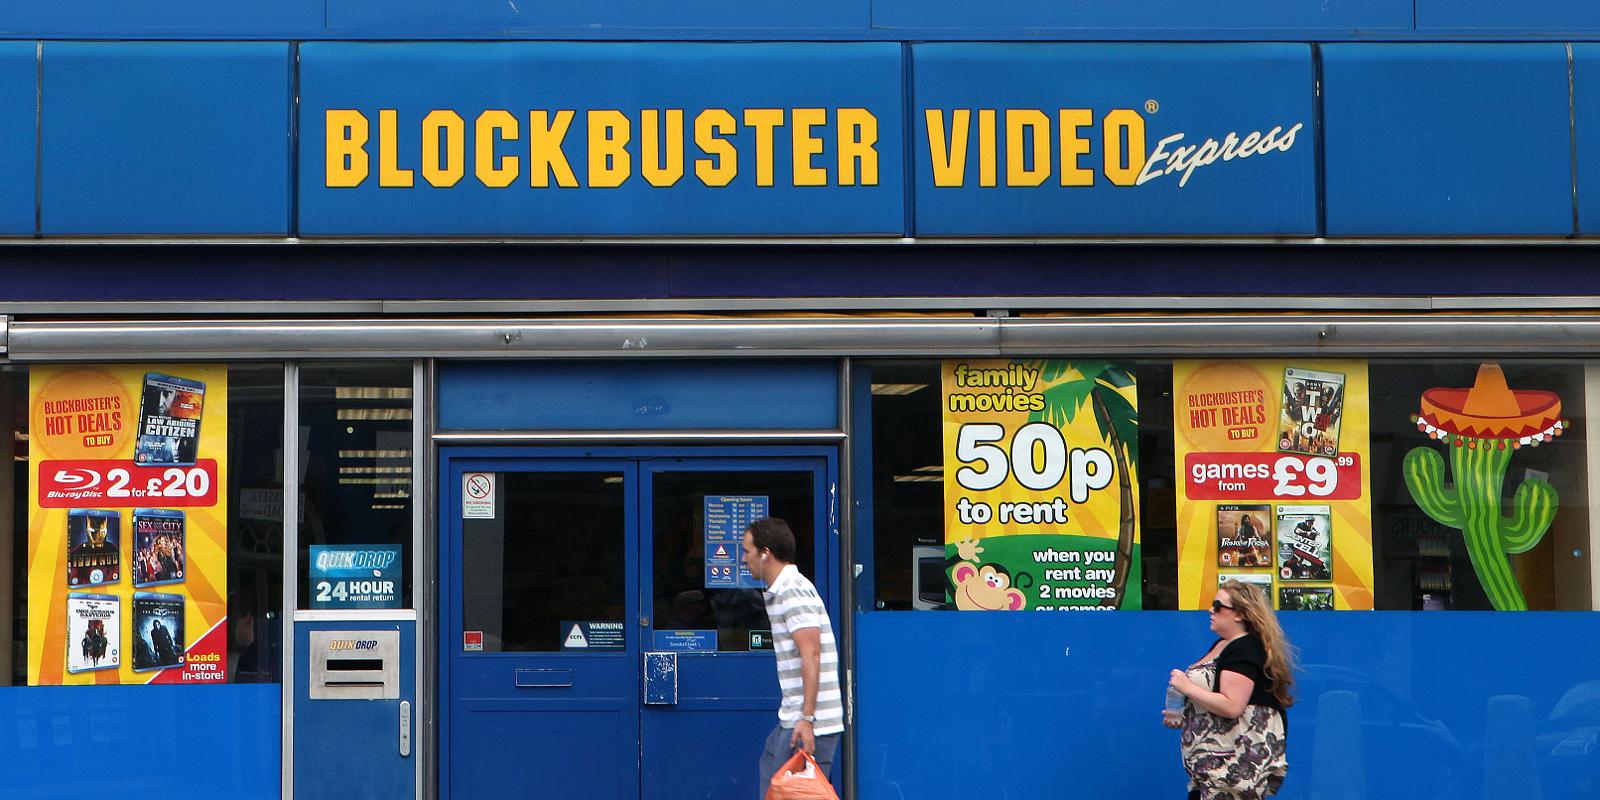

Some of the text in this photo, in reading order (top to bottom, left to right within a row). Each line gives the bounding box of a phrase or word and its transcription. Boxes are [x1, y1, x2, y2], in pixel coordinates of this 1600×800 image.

[325, 108, 1147, 189] BLOCKBUSTER VIDEO
[1136, 122, 1304, 188] Express
[955, 363, 1039, 392] family
[45, 396, 121, 415] BLOCKBUSTER'S
[949, 388, 1046, 413] movies
[1188, 390, 1264, 408] BLOCKBUSTER'S
[45, 411, 122, 436] HOT DEALS
[147, 417, 165, 426] LAW
[1190, 405, 1266, 428] HOT DEALS
[85, 435, 112, 446] TO BUY
[145, 424, 196, 439] CITIZEN
[1230, 428, 1256, 439] TO BUY
[955, 421, 1114, 503] 50p
[1191, 462, 1271, 484] games
[106, 467, 210, 498] 2 for £20
[1217, 480, 1246, 491] from
[47, 490, 103, 499] Blu-ray Disc
[956, 496, 1068, 525] to rent
[138, 521, 153, 530] SEX
[162, 521, 182, 530] CITY
[1032, 547, 1116, 566] when you
[1044, 566, 1117, 584] rent any
[316, 581, 394, 602] 24 HOUR
[349, 594, 394, 602] rental return
[1039, 583, 1117, 599] 2 movies
[589, 622, 624, 630] WARNING
[186, 652, 221, 662] Loads
[182, 670, 225, 680] in-store!
[190, 663, 217, 671] more
